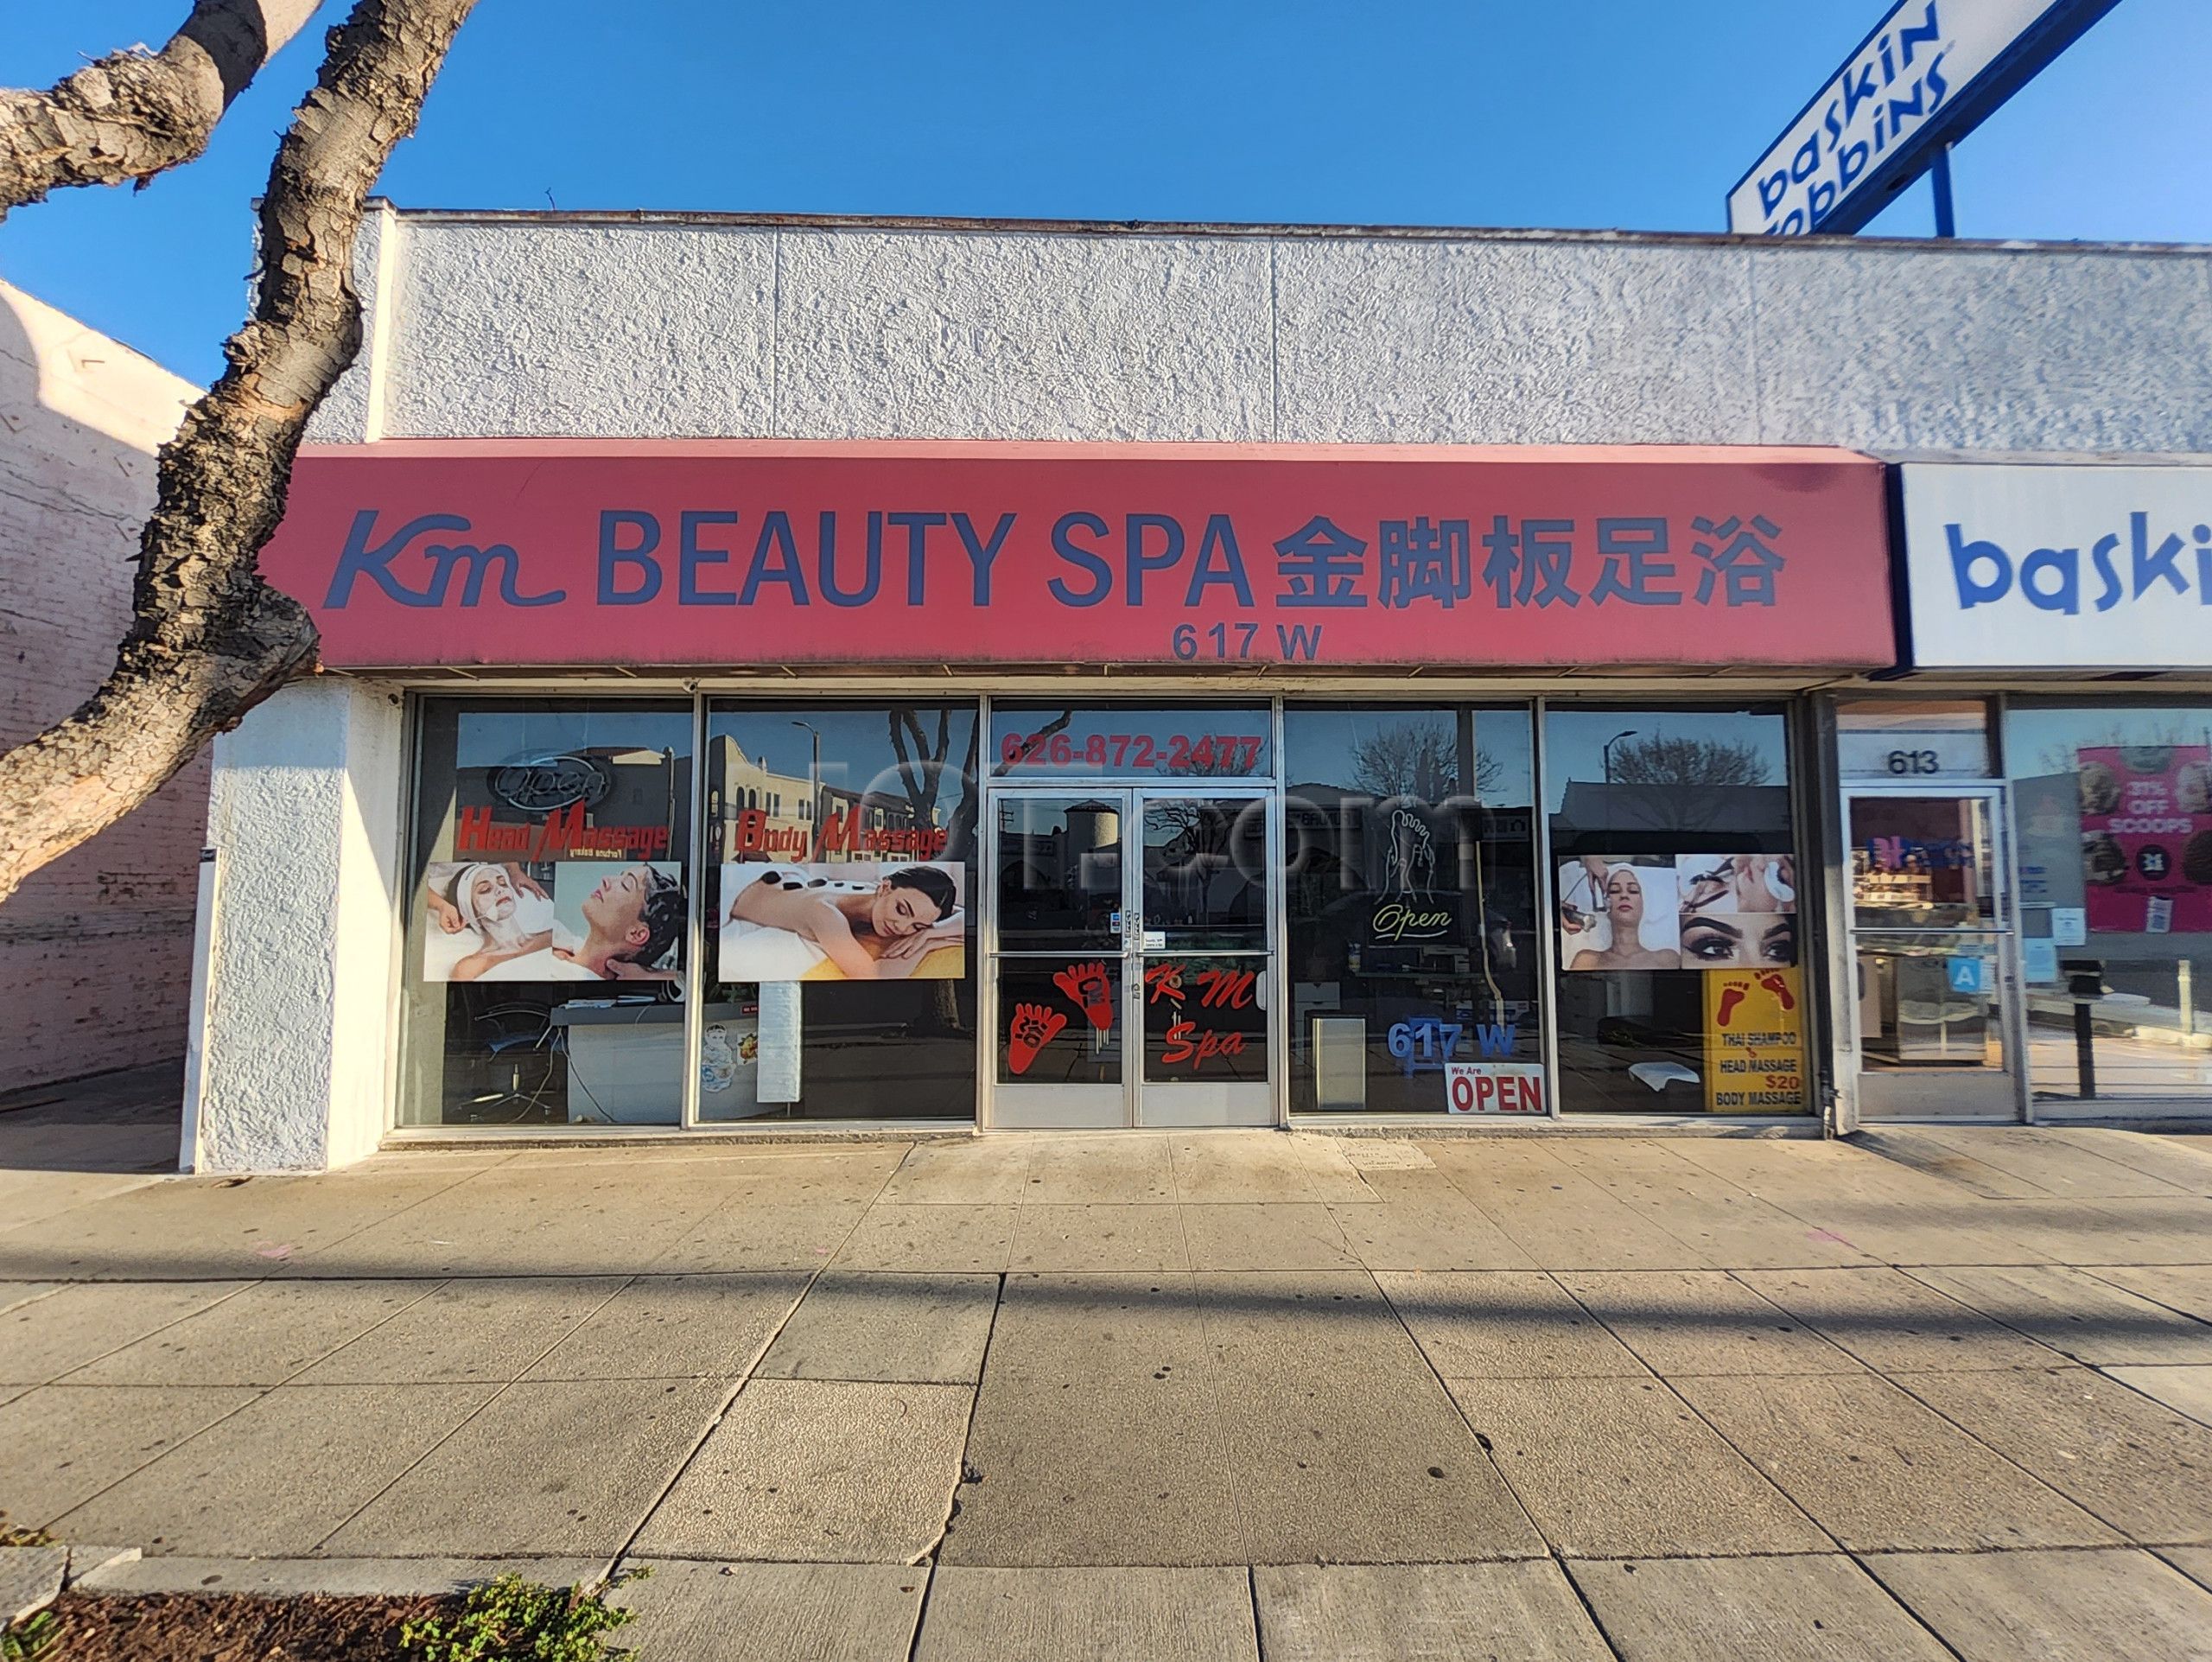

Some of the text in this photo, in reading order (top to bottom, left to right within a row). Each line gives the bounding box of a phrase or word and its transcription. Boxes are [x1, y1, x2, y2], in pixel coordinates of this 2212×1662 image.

[322, 509, 1255, 608] Km BEAUTY SPA
[1272, 514, 1786, 609] 金脚板足浴
[1172, 621, 1323, 660] 617 W
[1001, 733, 1262, 768] 626-872-2477
[1887, 749, 1939, 775] 613
[455, 796, 669, 862] Head Massage
[734, 805, 949, 863] Body Massage
[2107, 818, 2193, 834] SCOOPS
[1373, 904, 1452, 941] Open
[1145, 963, 1255, 1009] K M
[1955, 965, 1975, 985] A
[1161, 1022, 1247, 1071] Spa
[1388, 1022, 1516, 1059] 617 W
[1451, 1067, 1482, 1075] We Are
[1720, 1060, 1797, 1073] HEAD MASSAGE
[1765, 1074, 1800, 1090] $20
[1452, 1076, 1542, 1112] OPEN
[1716, 1091, 1802, 1105] BODY MASSAGE
